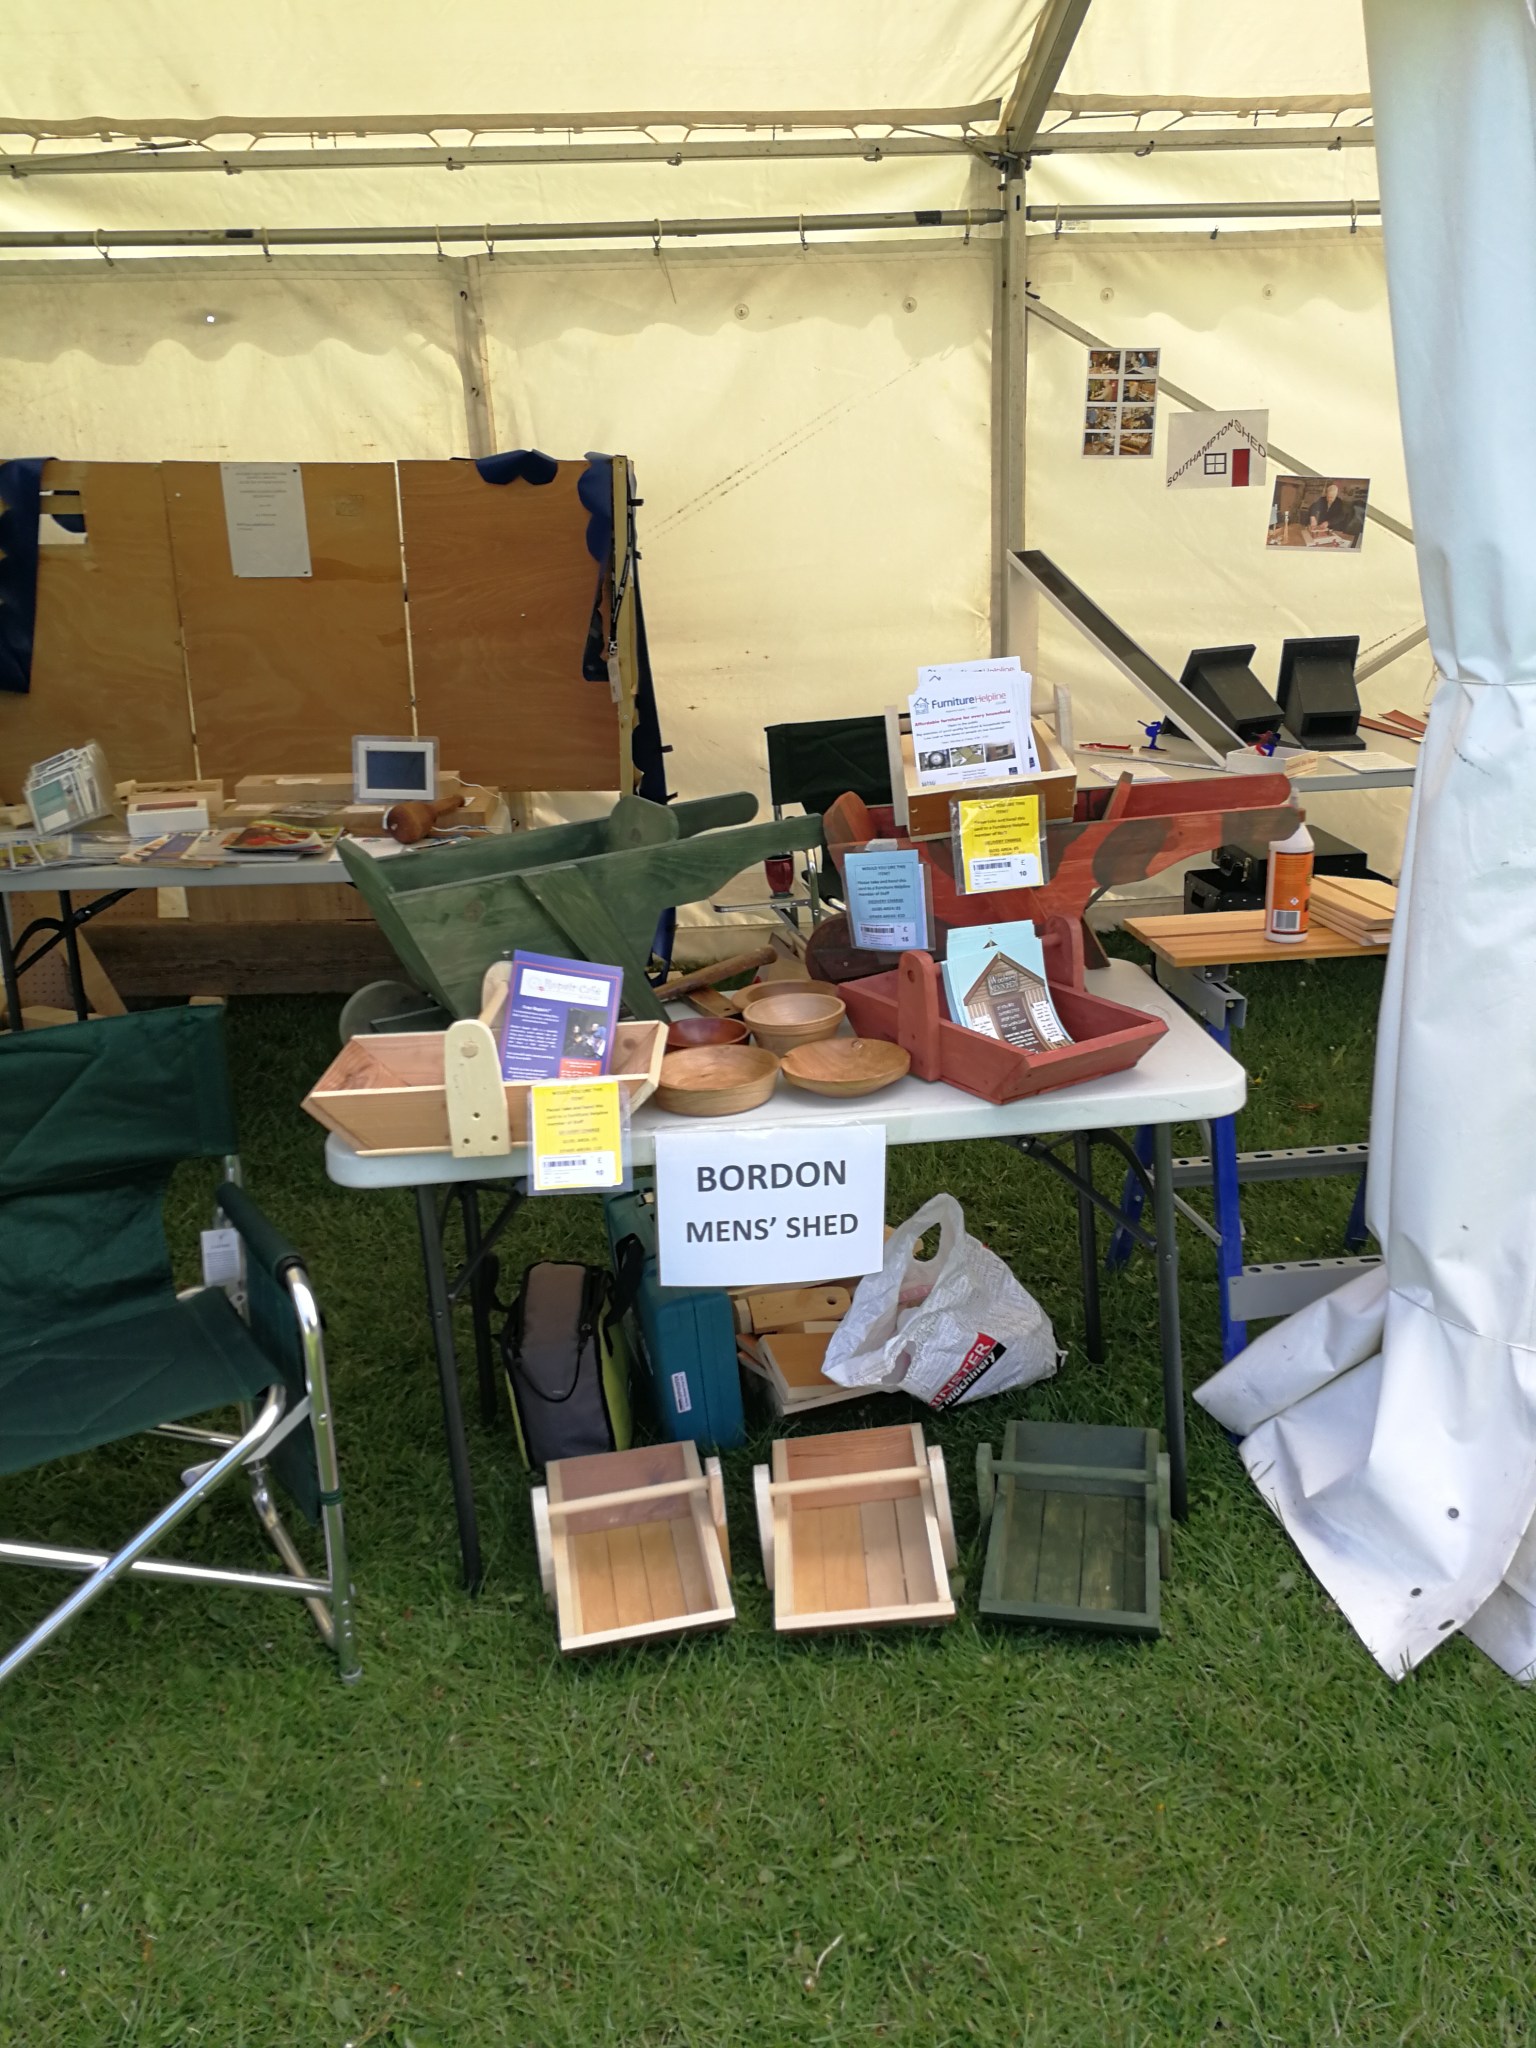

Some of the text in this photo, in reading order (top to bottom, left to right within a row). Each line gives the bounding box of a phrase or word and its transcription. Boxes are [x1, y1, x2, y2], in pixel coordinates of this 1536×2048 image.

[1167, 419, 1266, 487] SOUTHAMPTON SHED
[697, 1160, 846, 1192] BORDON
[686, 1213, 859, 1243] MENS' SHED
[944, 1351, 996, 1405] Machinery
